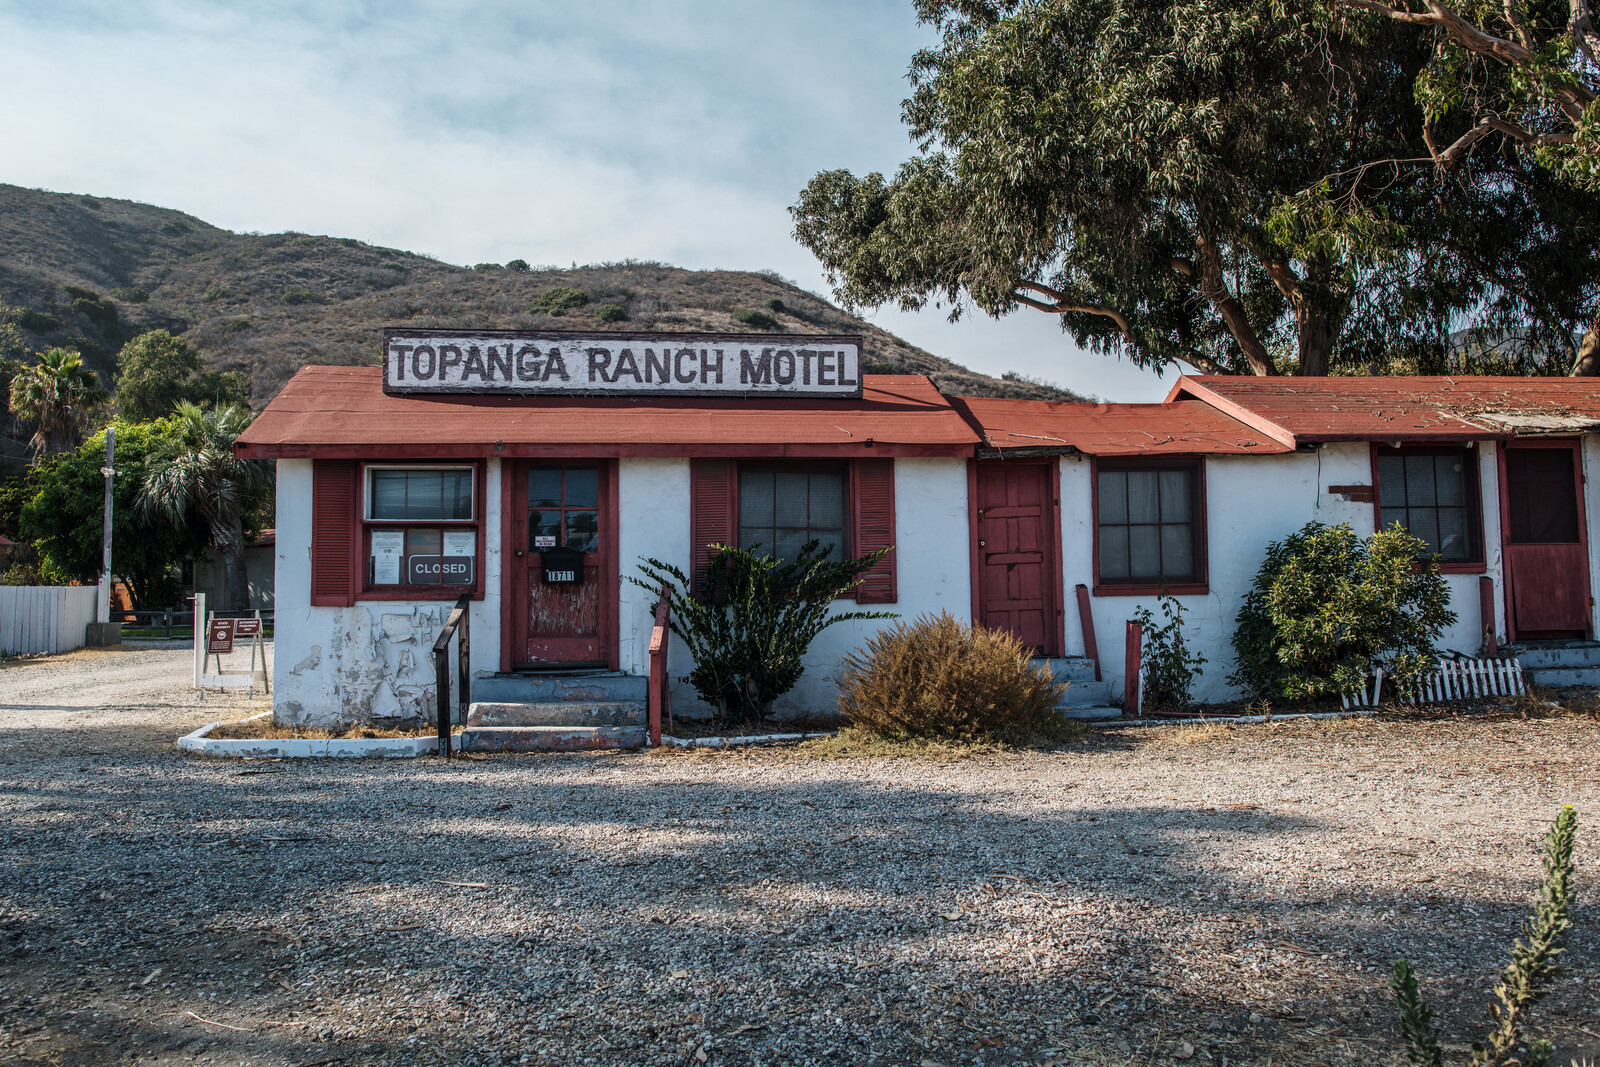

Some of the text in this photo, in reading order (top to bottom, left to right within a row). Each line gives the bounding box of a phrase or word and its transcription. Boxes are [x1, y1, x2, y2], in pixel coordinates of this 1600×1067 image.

[389, 343, 857, 386] TOPANGA RANCH MOTEL
[415, 564, 467, 574] CLOSED
[550, 572, 573, 580] 18711
